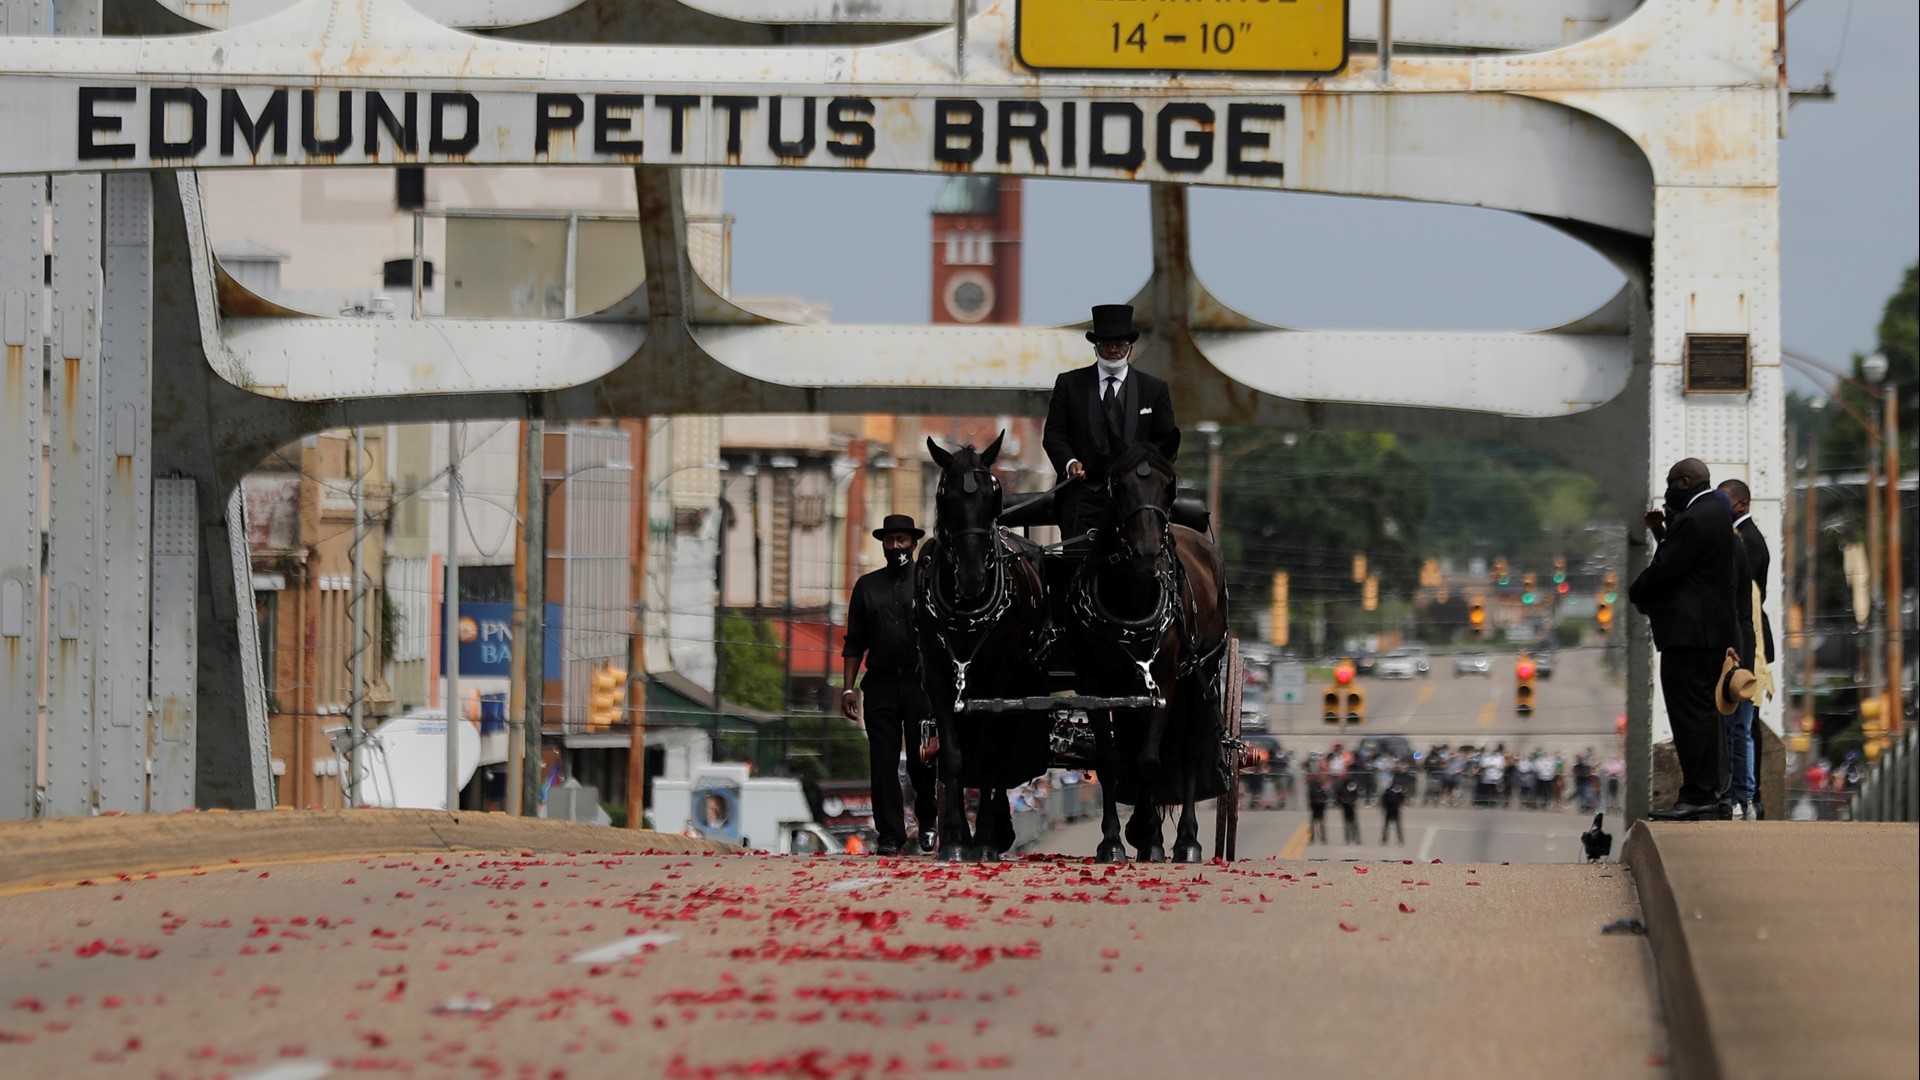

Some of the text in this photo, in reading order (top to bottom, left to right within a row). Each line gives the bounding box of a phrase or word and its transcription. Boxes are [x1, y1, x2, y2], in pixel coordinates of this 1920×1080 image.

[78, 86, 1285, 178] EDMUND PETTUS BRIDGE
[480, 620, 513, 642] PN
[481, 645, 512, 664] BA
